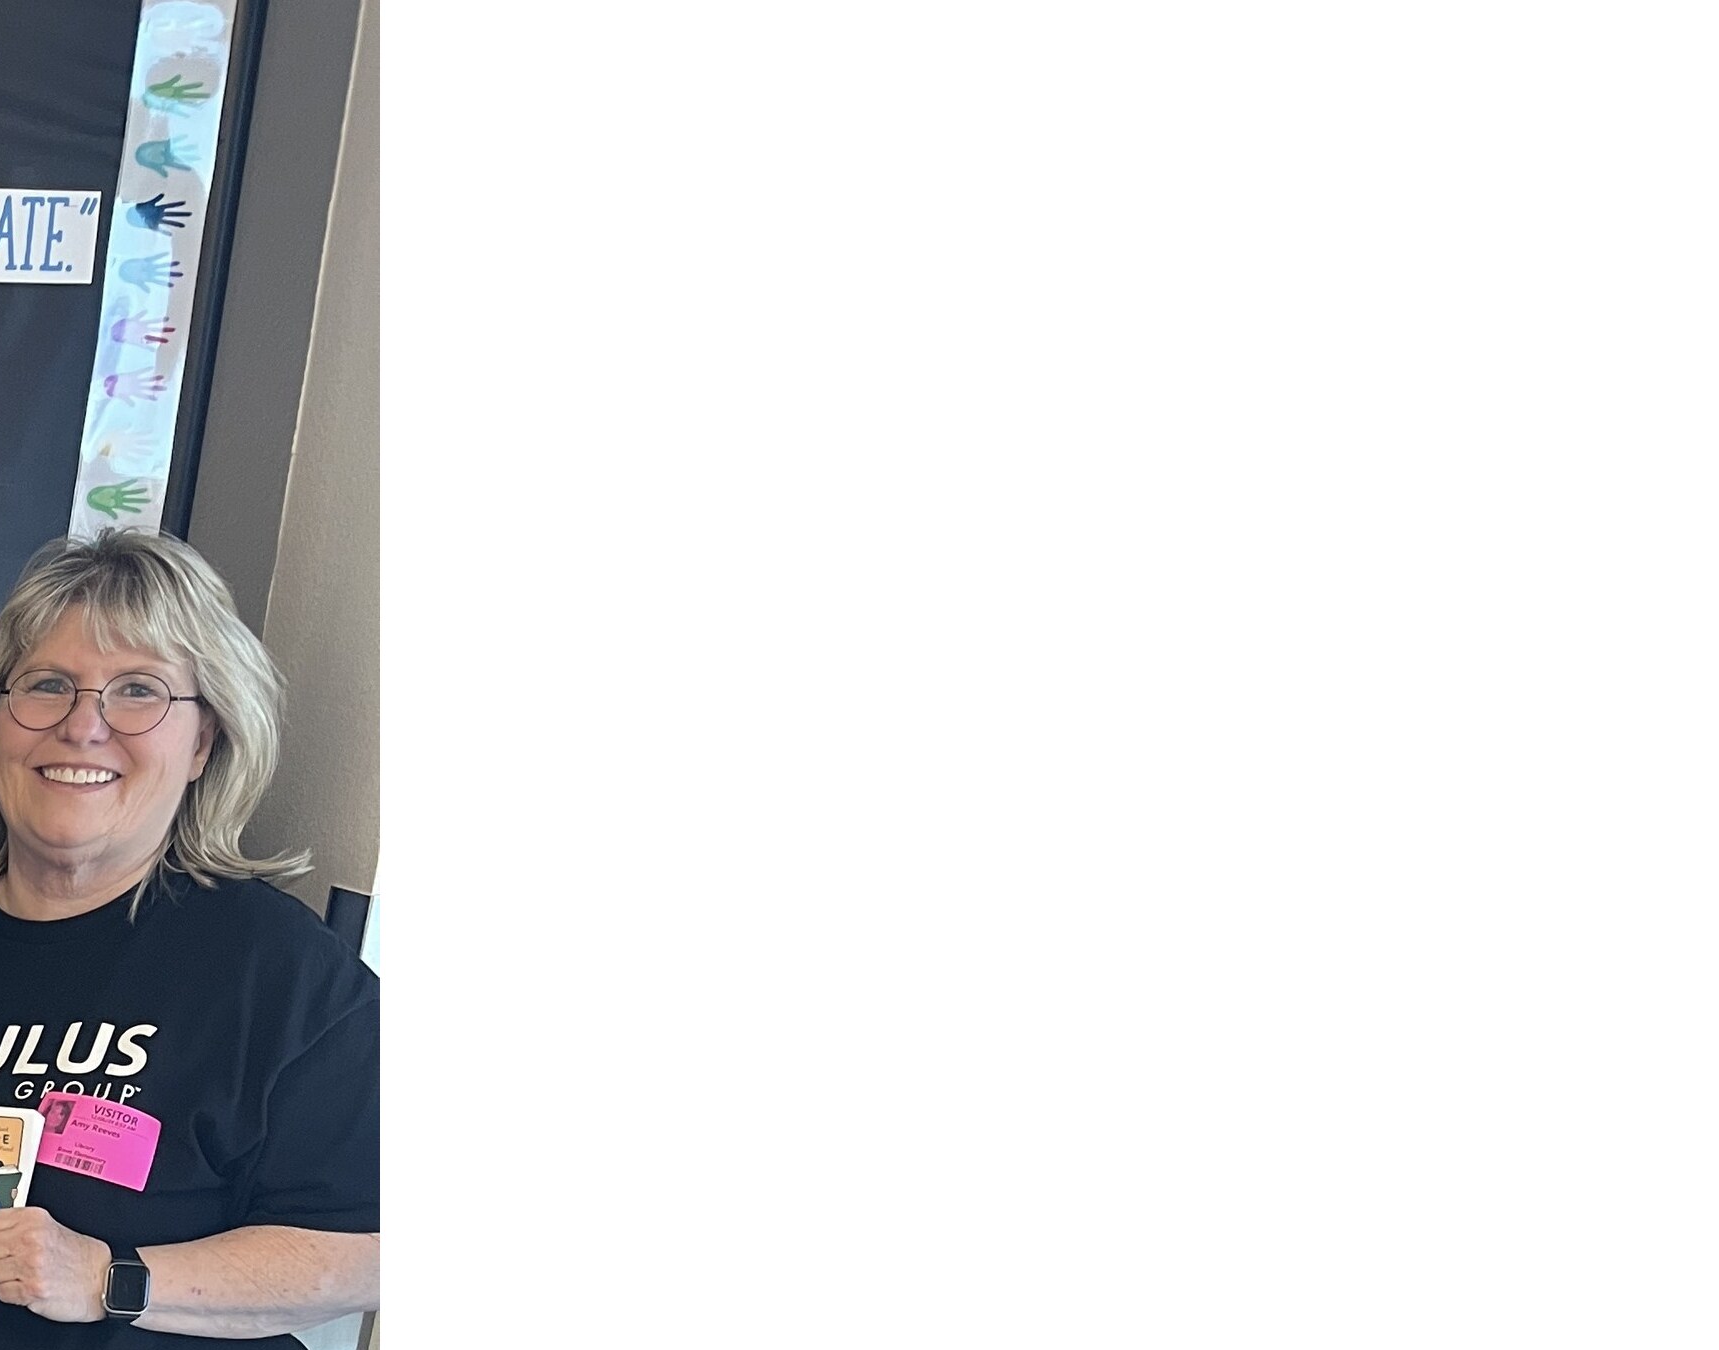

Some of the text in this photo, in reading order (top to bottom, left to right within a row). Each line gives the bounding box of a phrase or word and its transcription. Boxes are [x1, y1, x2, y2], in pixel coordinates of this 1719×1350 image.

[94, 1104, 139, 1127] VISITOR
[70, 1119, 121, 1139] Amy Reeves
